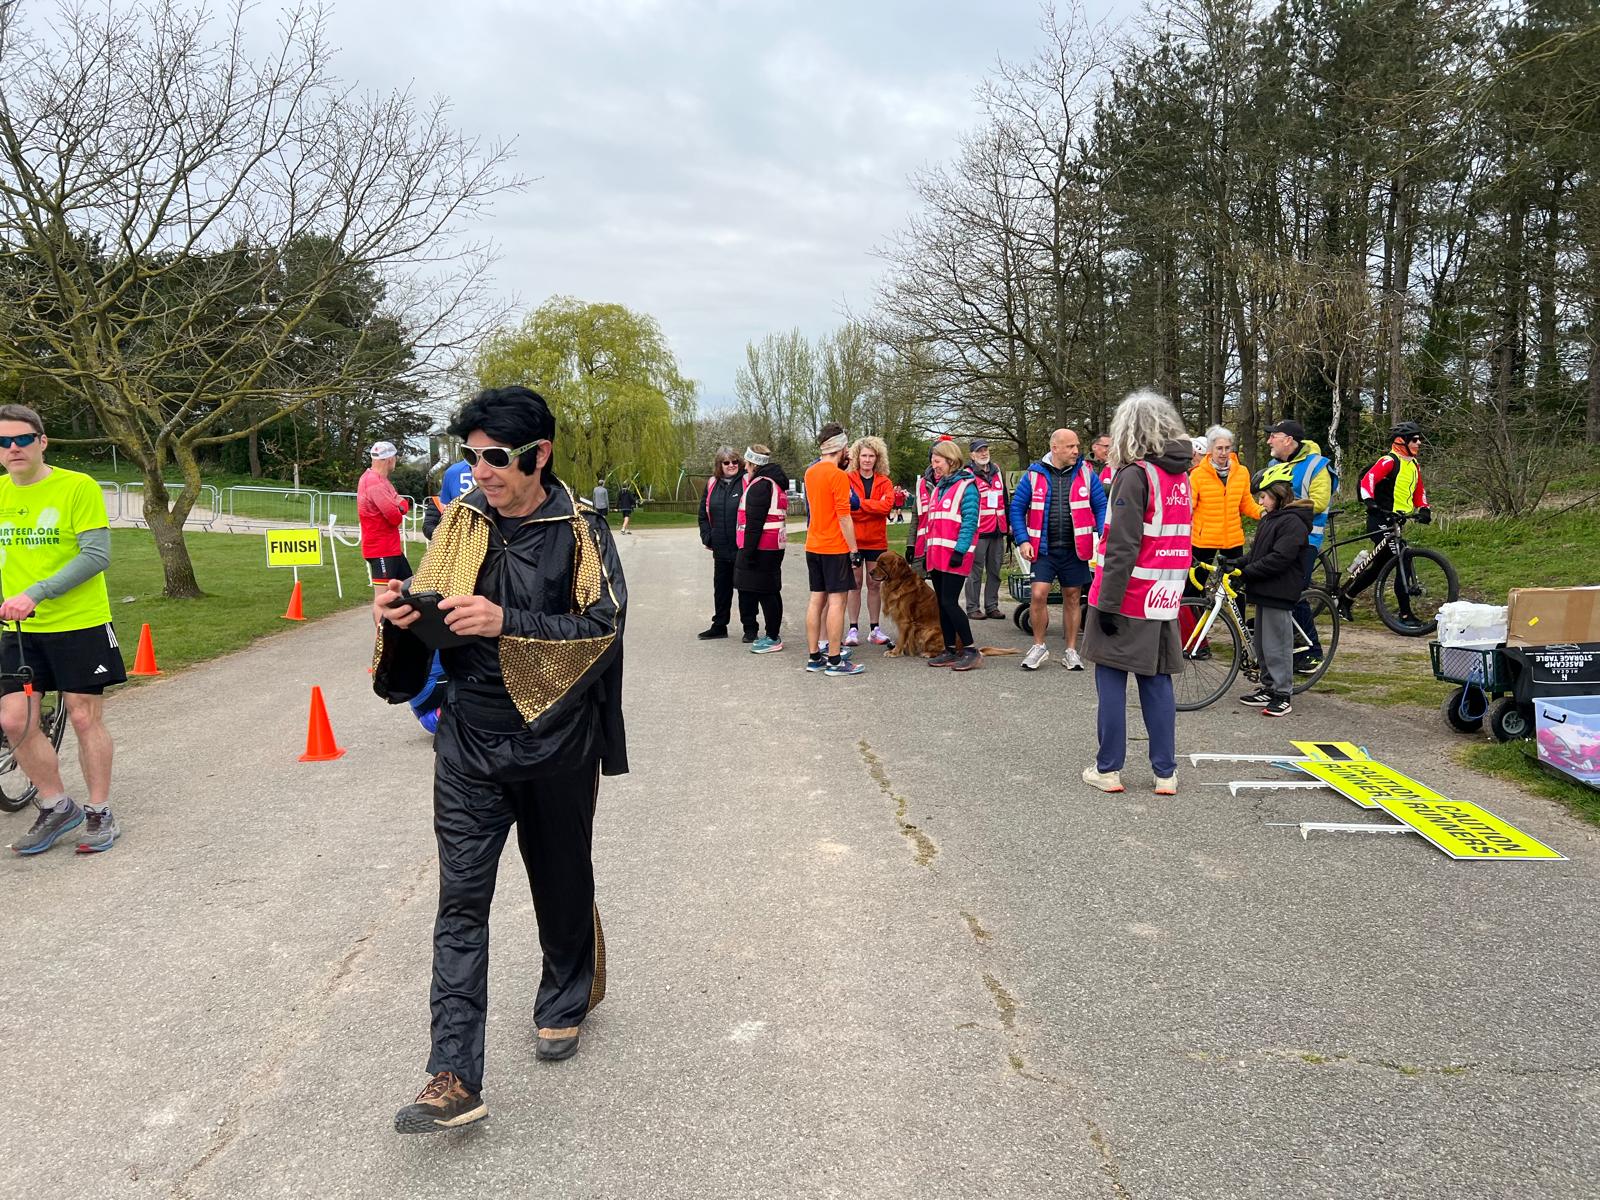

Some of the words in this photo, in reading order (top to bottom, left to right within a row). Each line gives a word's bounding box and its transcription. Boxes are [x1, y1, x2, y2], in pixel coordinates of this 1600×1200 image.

[460, 472, 477, 493] 5
[0, 528, 60, 536] IRTEEN.ONE
[0, 538, 12, 546] 22
[16, 537, 60, 545] FINISHER
[271, 540, 317, 553] FINISH
[1350, 538, 1387, 579] SPECIALIZED
[1320, 763, 1393, 797] RUNNER
[1347, 764, 1421, 800] CAUTION
[1403, 802, 1500, 854] RUNNERS
[1435, 805, 1528, 852] CAUTION
